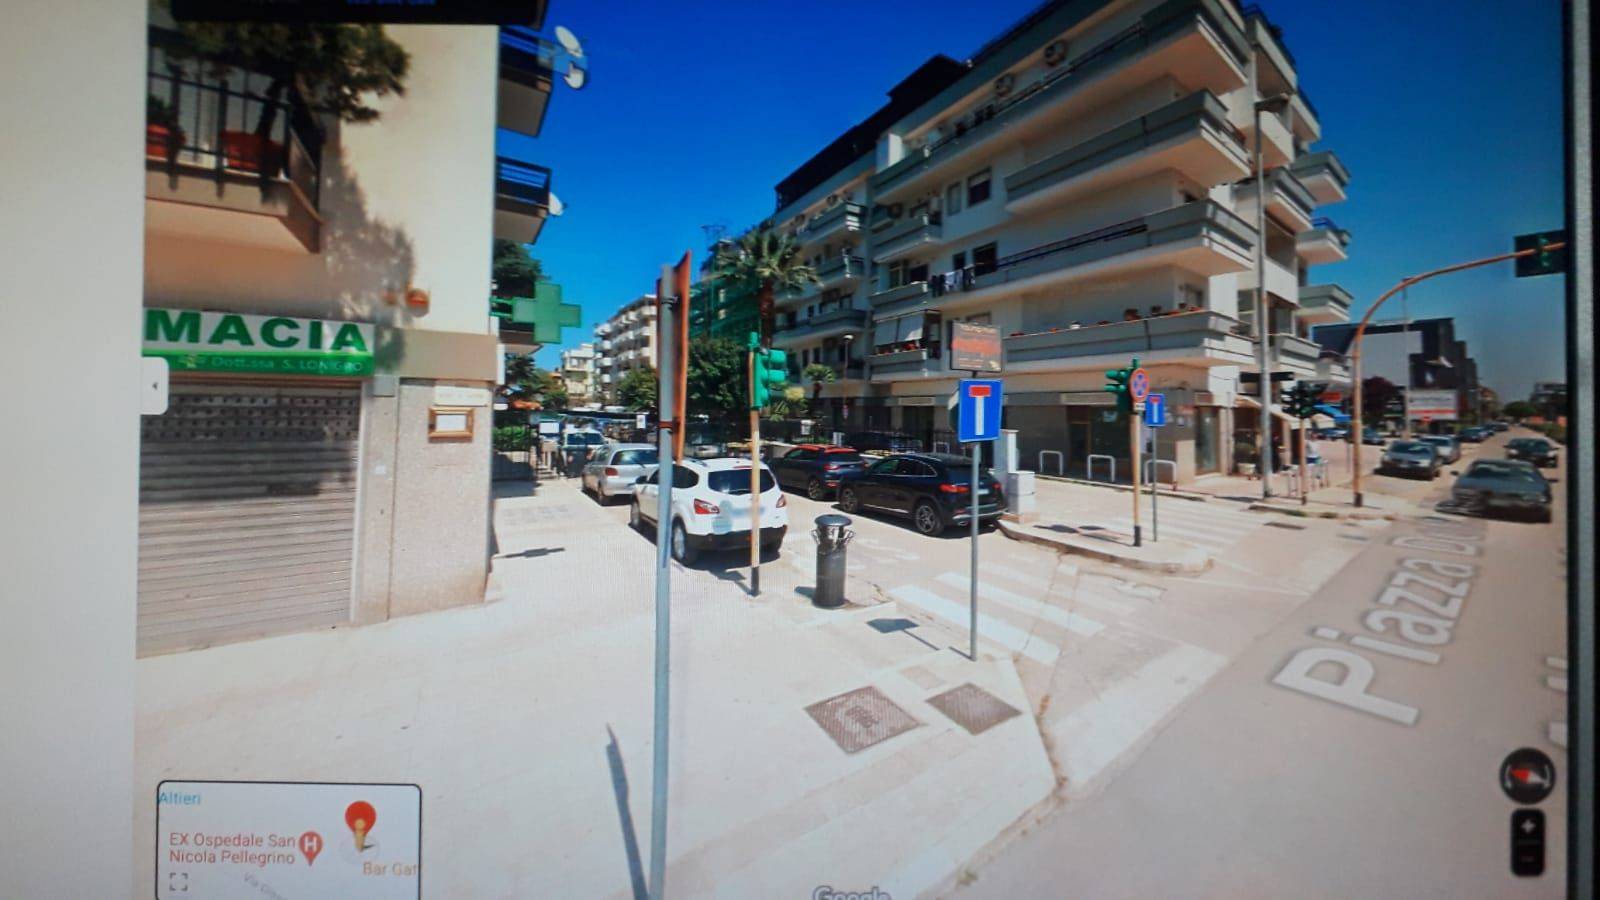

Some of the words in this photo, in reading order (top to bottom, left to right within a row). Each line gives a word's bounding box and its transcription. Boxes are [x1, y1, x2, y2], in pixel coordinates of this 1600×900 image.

[144, 309, 369, 352] MACIA
[1271, 557, 1479, 726] Piazza
[158, 791, 201, 805] Altieri
[169, 833, 189, 846] EX
[193, 832, 264, 851] Ospedale
[268, 834, 296, 847] San
[169, 850, 216, 863] Nicola
[220, 850, 296, 868] Pellegrino
[362, 862, 387, 875] Bar
